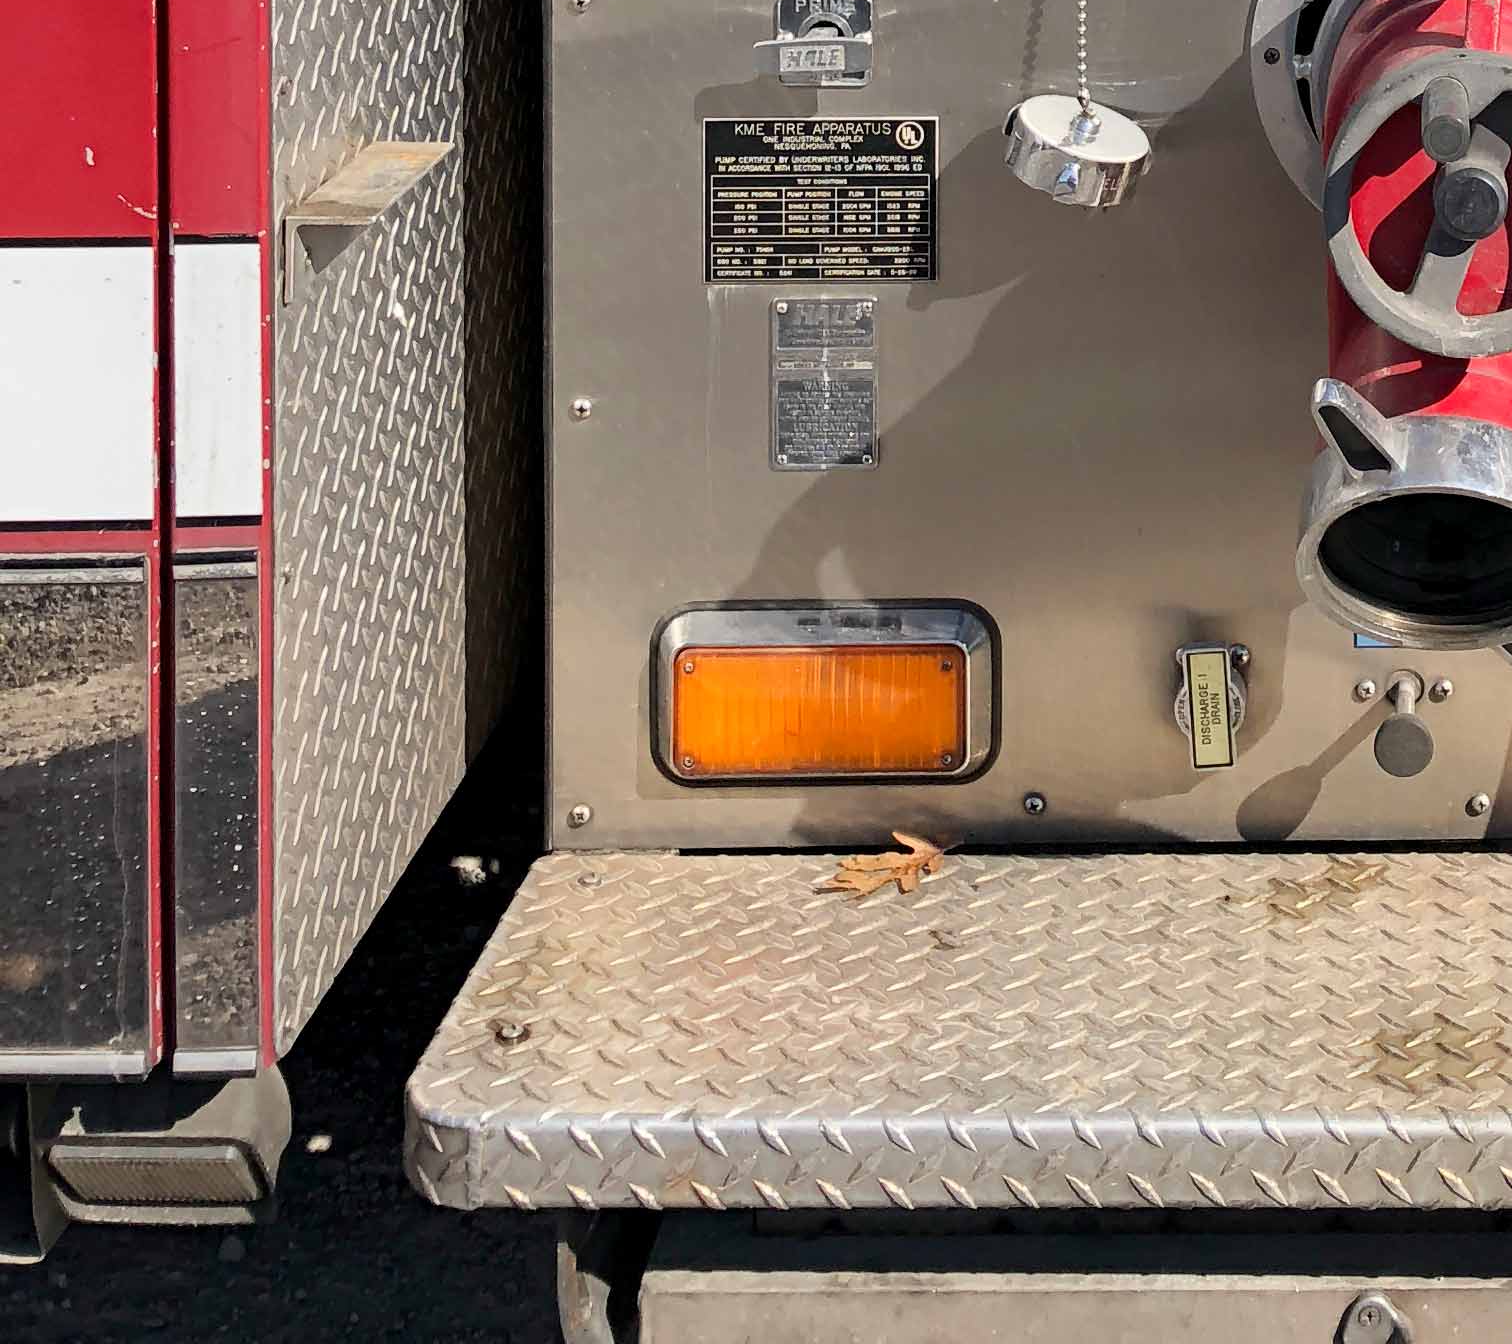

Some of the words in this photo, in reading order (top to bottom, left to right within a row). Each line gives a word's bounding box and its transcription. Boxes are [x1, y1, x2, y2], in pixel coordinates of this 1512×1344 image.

[734, 123, 765, 136] KME
[774, 123, 805, 135] FIRE
[812, 122, 892, 135] APPARATUS
[715, 156, 736, 164] PUMP
[793, 164, 822, 172] SECTION
[844, 164, 853, 172] OF
[856, 164, 873, 172] NFPA
[801, 381, 849, 391] WARNING
[793, 423, 858, 432] LUBRICATION
[1198, 682, 1212, 745] DISCHARGE
[1210, 692, 1221, 725] DRAIN
